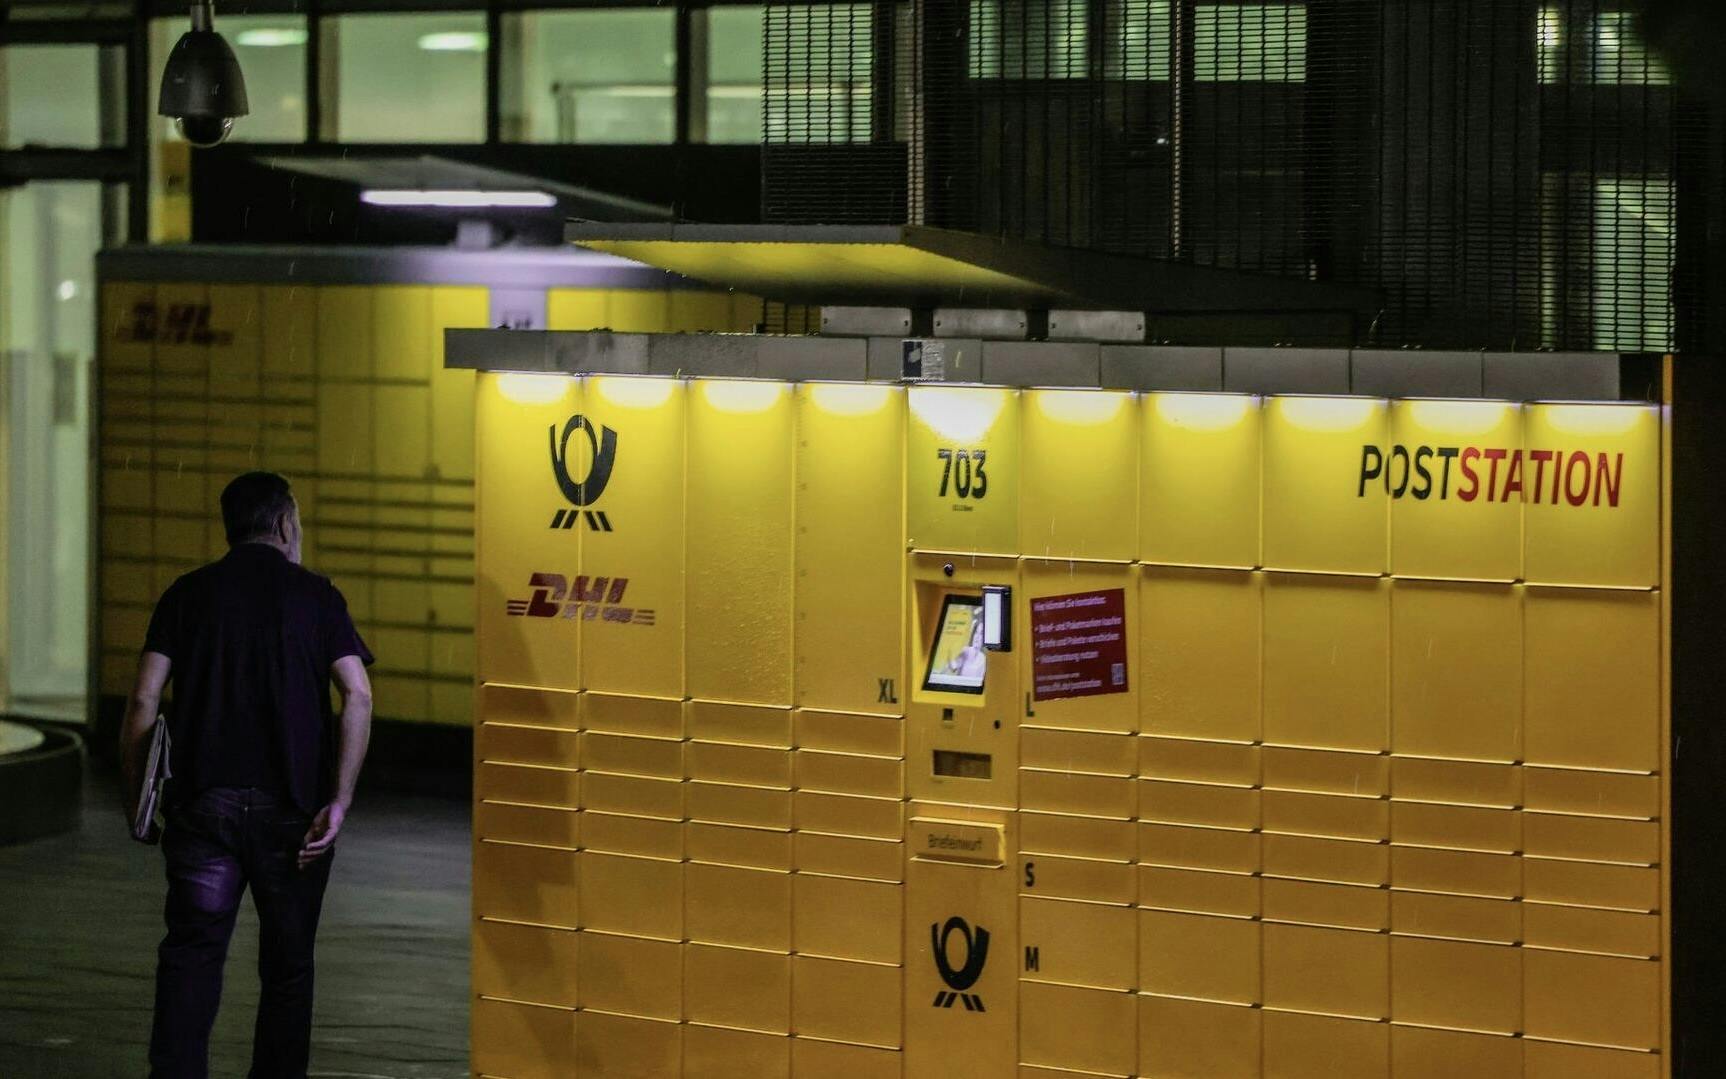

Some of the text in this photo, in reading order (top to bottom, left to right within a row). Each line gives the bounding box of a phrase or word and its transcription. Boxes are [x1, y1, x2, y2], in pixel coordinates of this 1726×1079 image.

[937, 448, 987, 499] 703
[1358, 444, 1623, 507] POSTSTATION
[527, 572, 635, 623] DHL
[878, 678, 898, 705] XL
[1026, 692, 1035, 717] L
[1025, 862, 1035, 887] S
[1025, 945, 1039, 972] M
